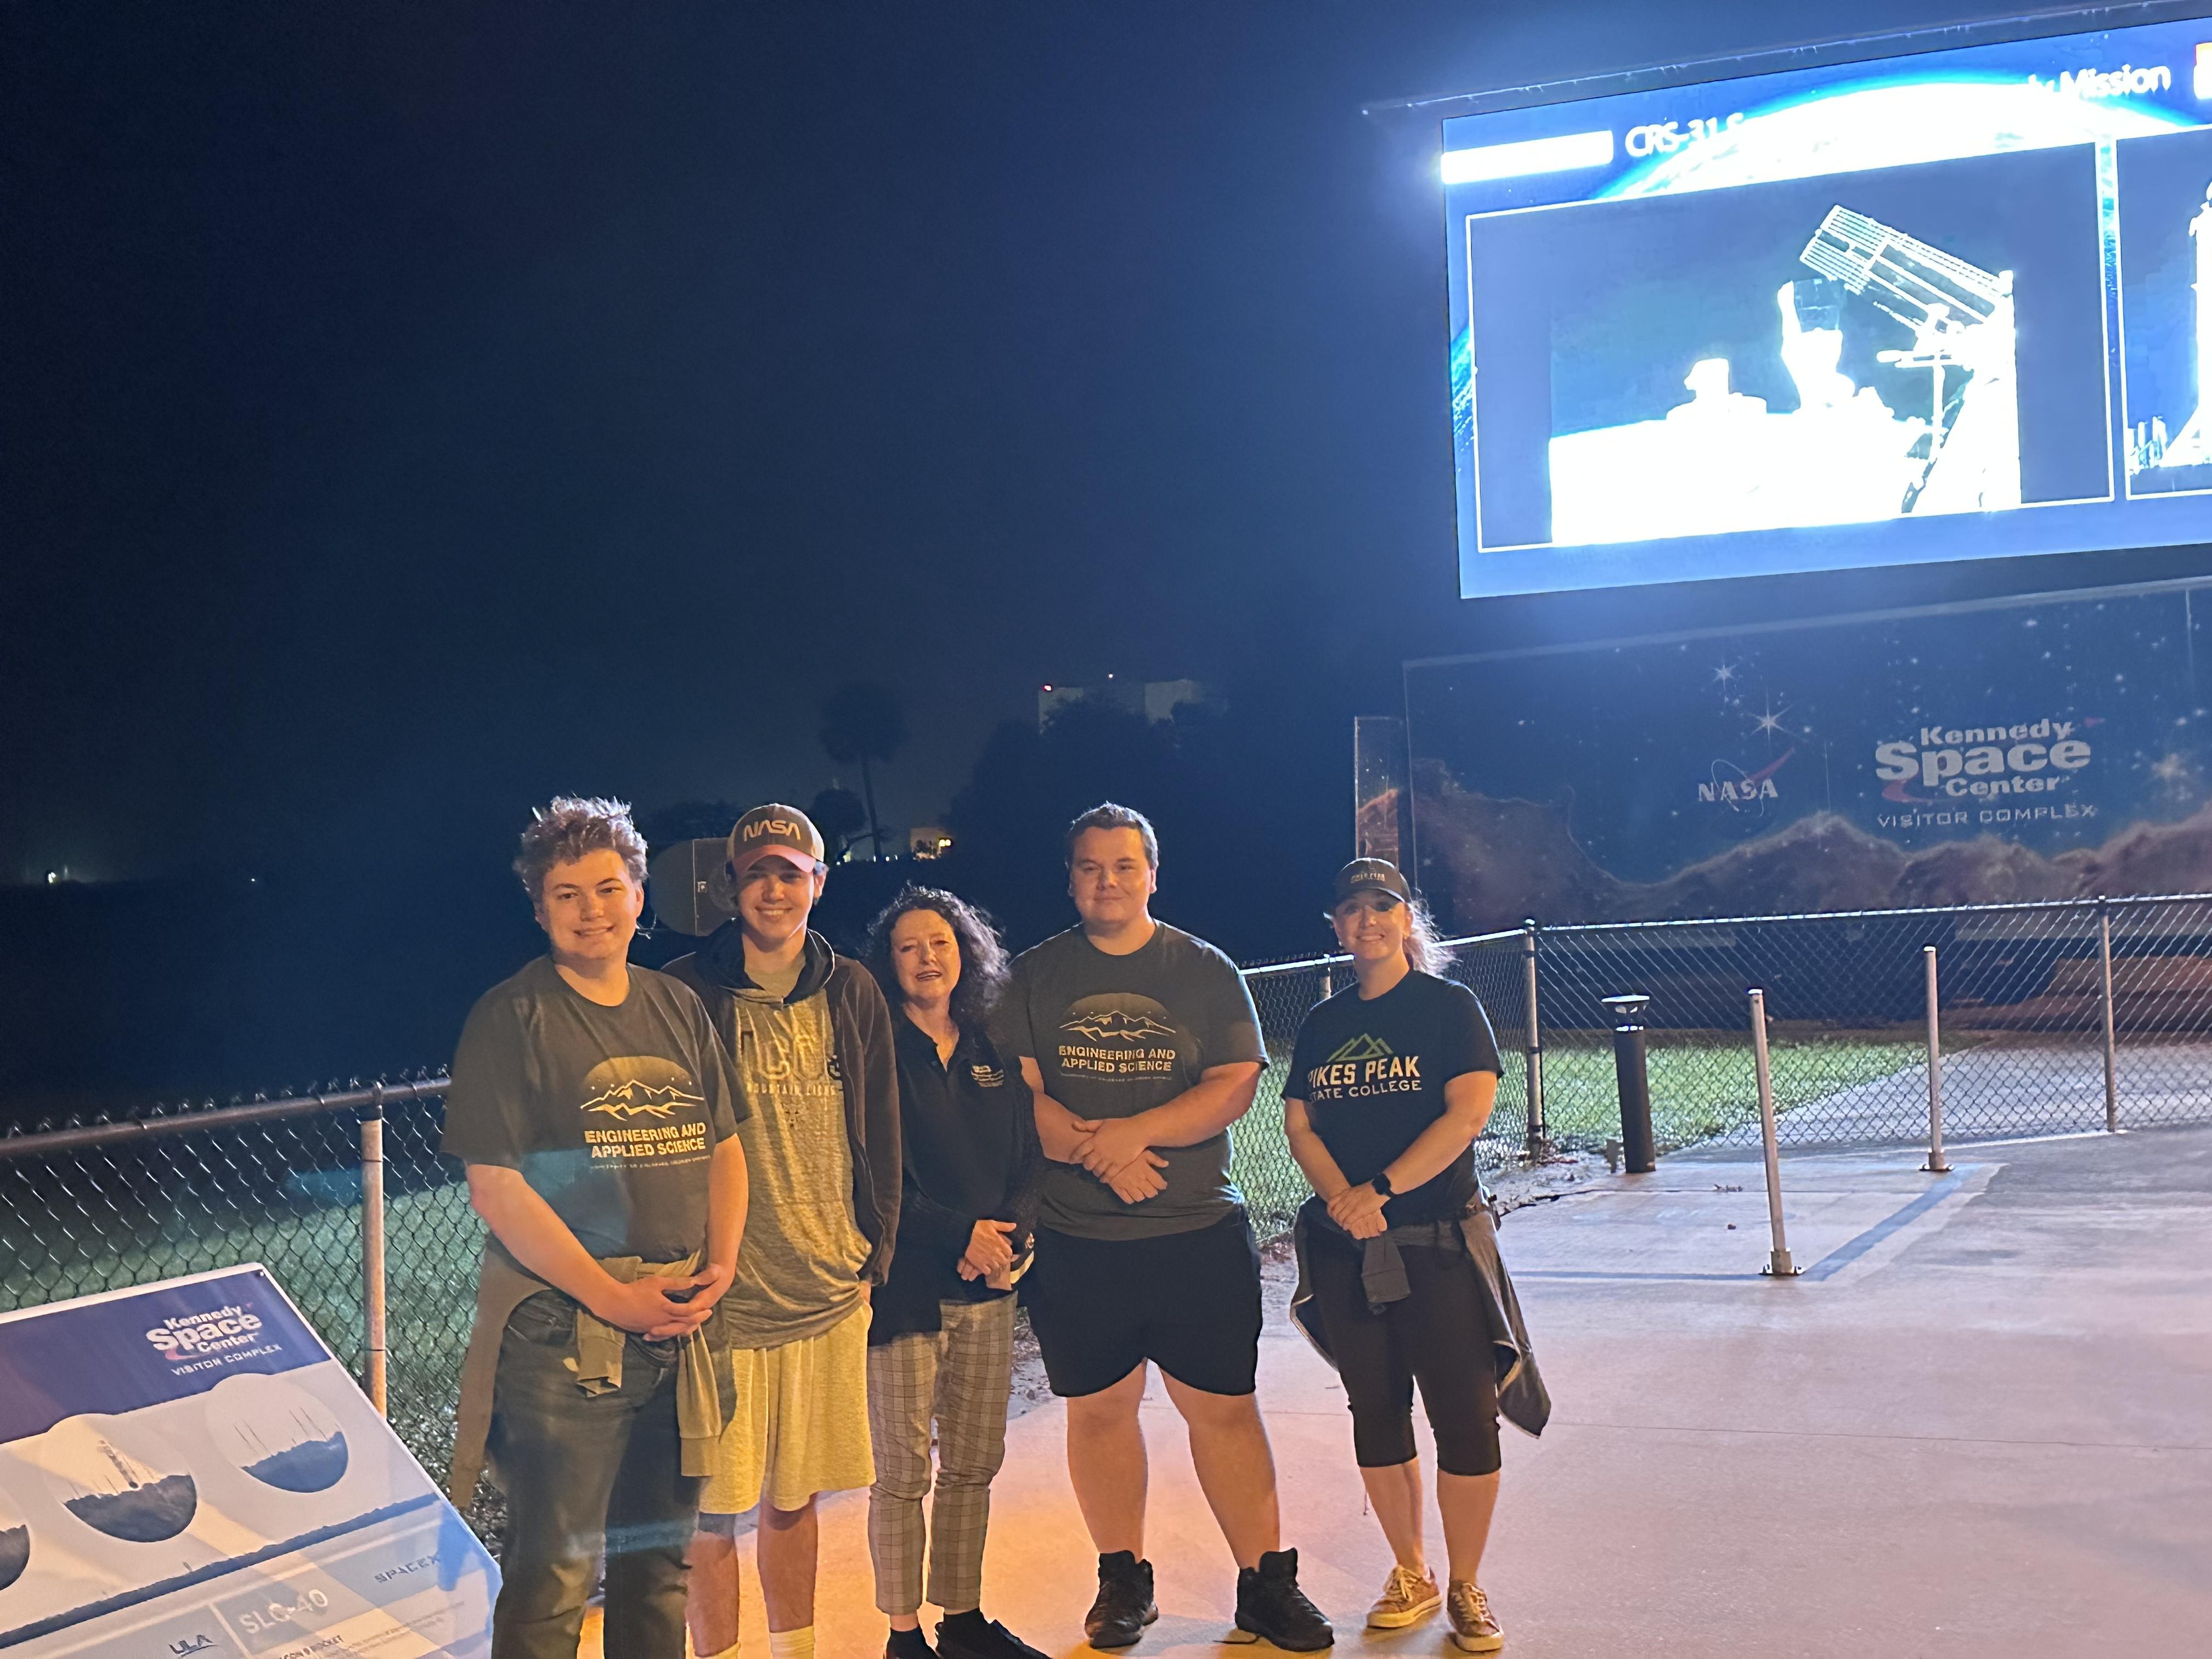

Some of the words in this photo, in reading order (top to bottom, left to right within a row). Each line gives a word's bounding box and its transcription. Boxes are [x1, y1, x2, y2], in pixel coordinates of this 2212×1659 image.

[2059, 64, 2171, 100] Mission
[1921, 718, 2073, 746] Kennedy
[1875, 740, 2091, 786] Space
[1698, 778, 1779, 802] NASA
[1945, 775, 2061, 797] Center
[1877, 811, 1968, 828] VISITOR
[1979, 803, 2098, 823] COMPLEX
[743, 819, 801, 842] NASA
[1058, 1045, 1145, 1061] ENGINEERING
[1148, 1048, 1176, 1060] AND
[1061, 1057, 1115, 1073] APPLIED
[1118, 1060, 1172, 1074] SCIENCE
[1365, 1056, 1420, 1083] PEAK
[1348, 1080, 1423, 1098] COLLEGE
[584, 1126, 679, 1144] ENGINEERING
[681, 1122, 707, 1136] AND
[591, 1143, 655, 1159] APPLIED
[657, 1137, 706, 1155] SCIENCE
[163, 1305, 244, 1330] Kennedy
[145, 1313, 263, 1351] Space
[197, 1333, 256, 1353] Center
[171, 1358, 222, 1376] VISITOR
[224, 1343, 283, 1363] COMPLEX
[374, 1550, 441, 1583] SPACEX
